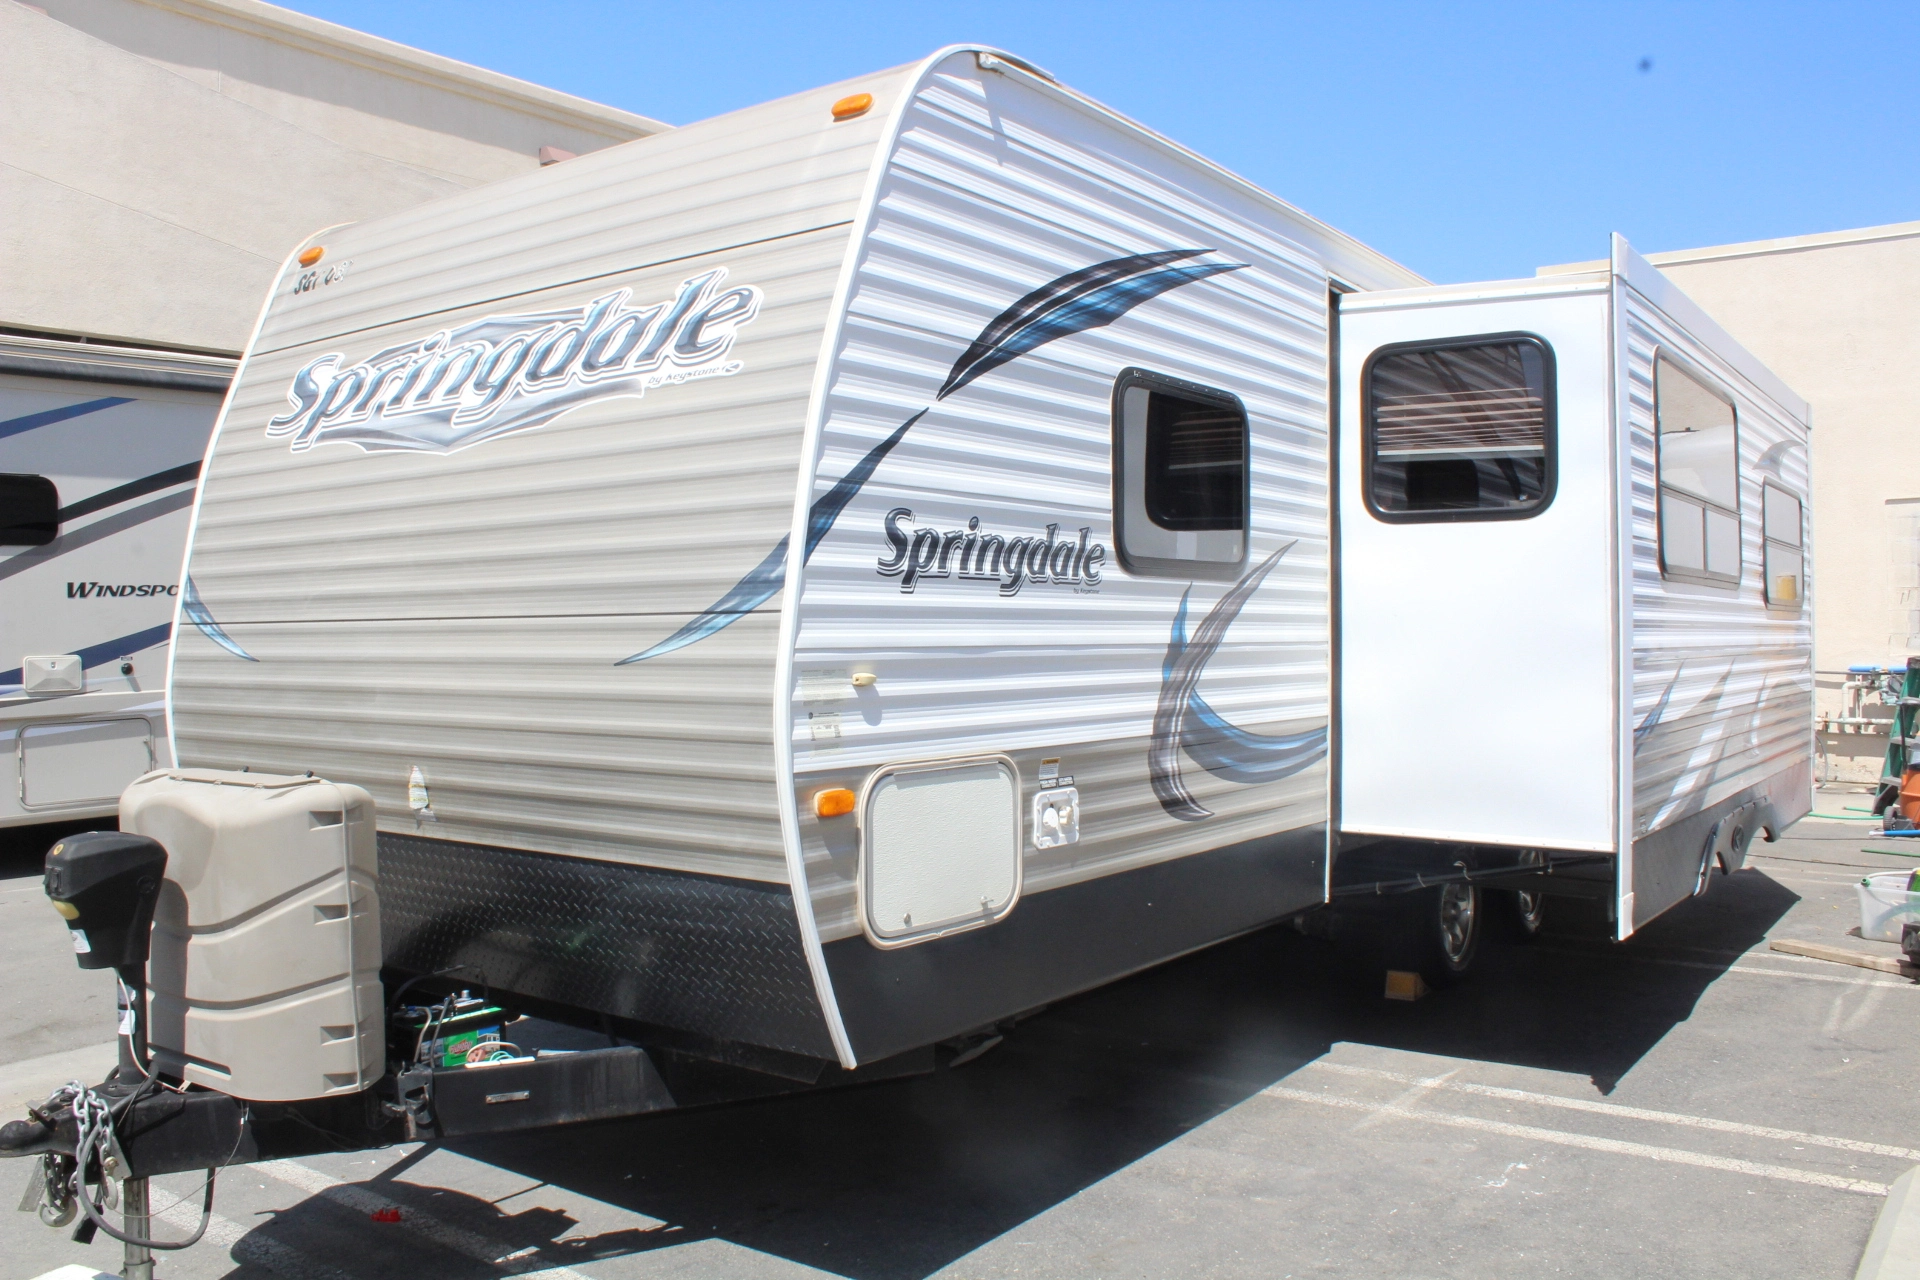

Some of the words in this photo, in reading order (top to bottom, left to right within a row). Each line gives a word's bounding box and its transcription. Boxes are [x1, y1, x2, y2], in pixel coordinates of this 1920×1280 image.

[266, 267, 763, 453] Springdale
[648, 375, 663, 385] by
[876, 507, 1106, 597] Springdale
